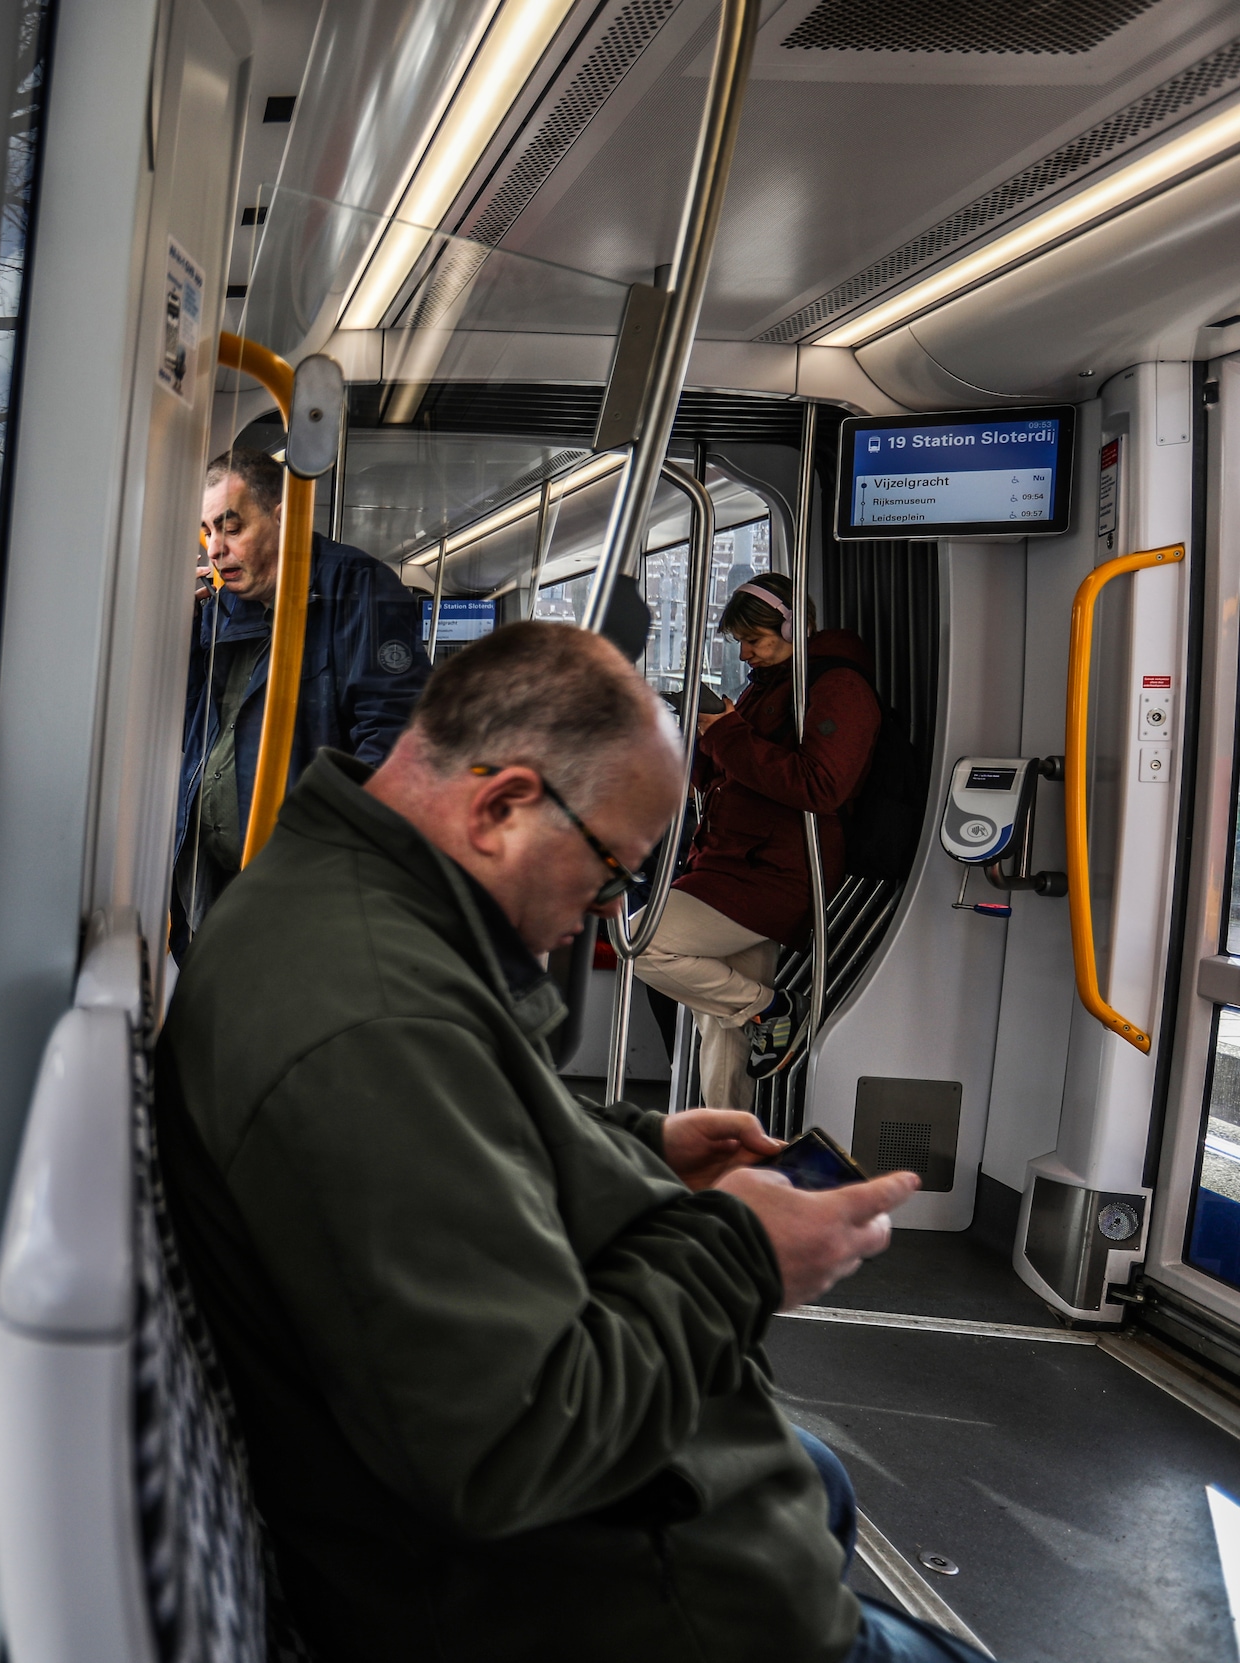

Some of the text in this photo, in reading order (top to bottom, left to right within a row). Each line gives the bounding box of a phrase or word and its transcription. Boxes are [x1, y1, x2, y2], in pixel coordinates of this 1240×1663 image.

[1028, 421, 1052, 429] 09:53
[887, 429, 1055, 449] 19 Station Sloterdij
[1033, 474, 1045, 482] Nu
[874, 476, 950, 490] Vijzelgracht
[873, 496, 936, 506] Rijksmuseum
[872, 513, 925, 522] Leidseplein
